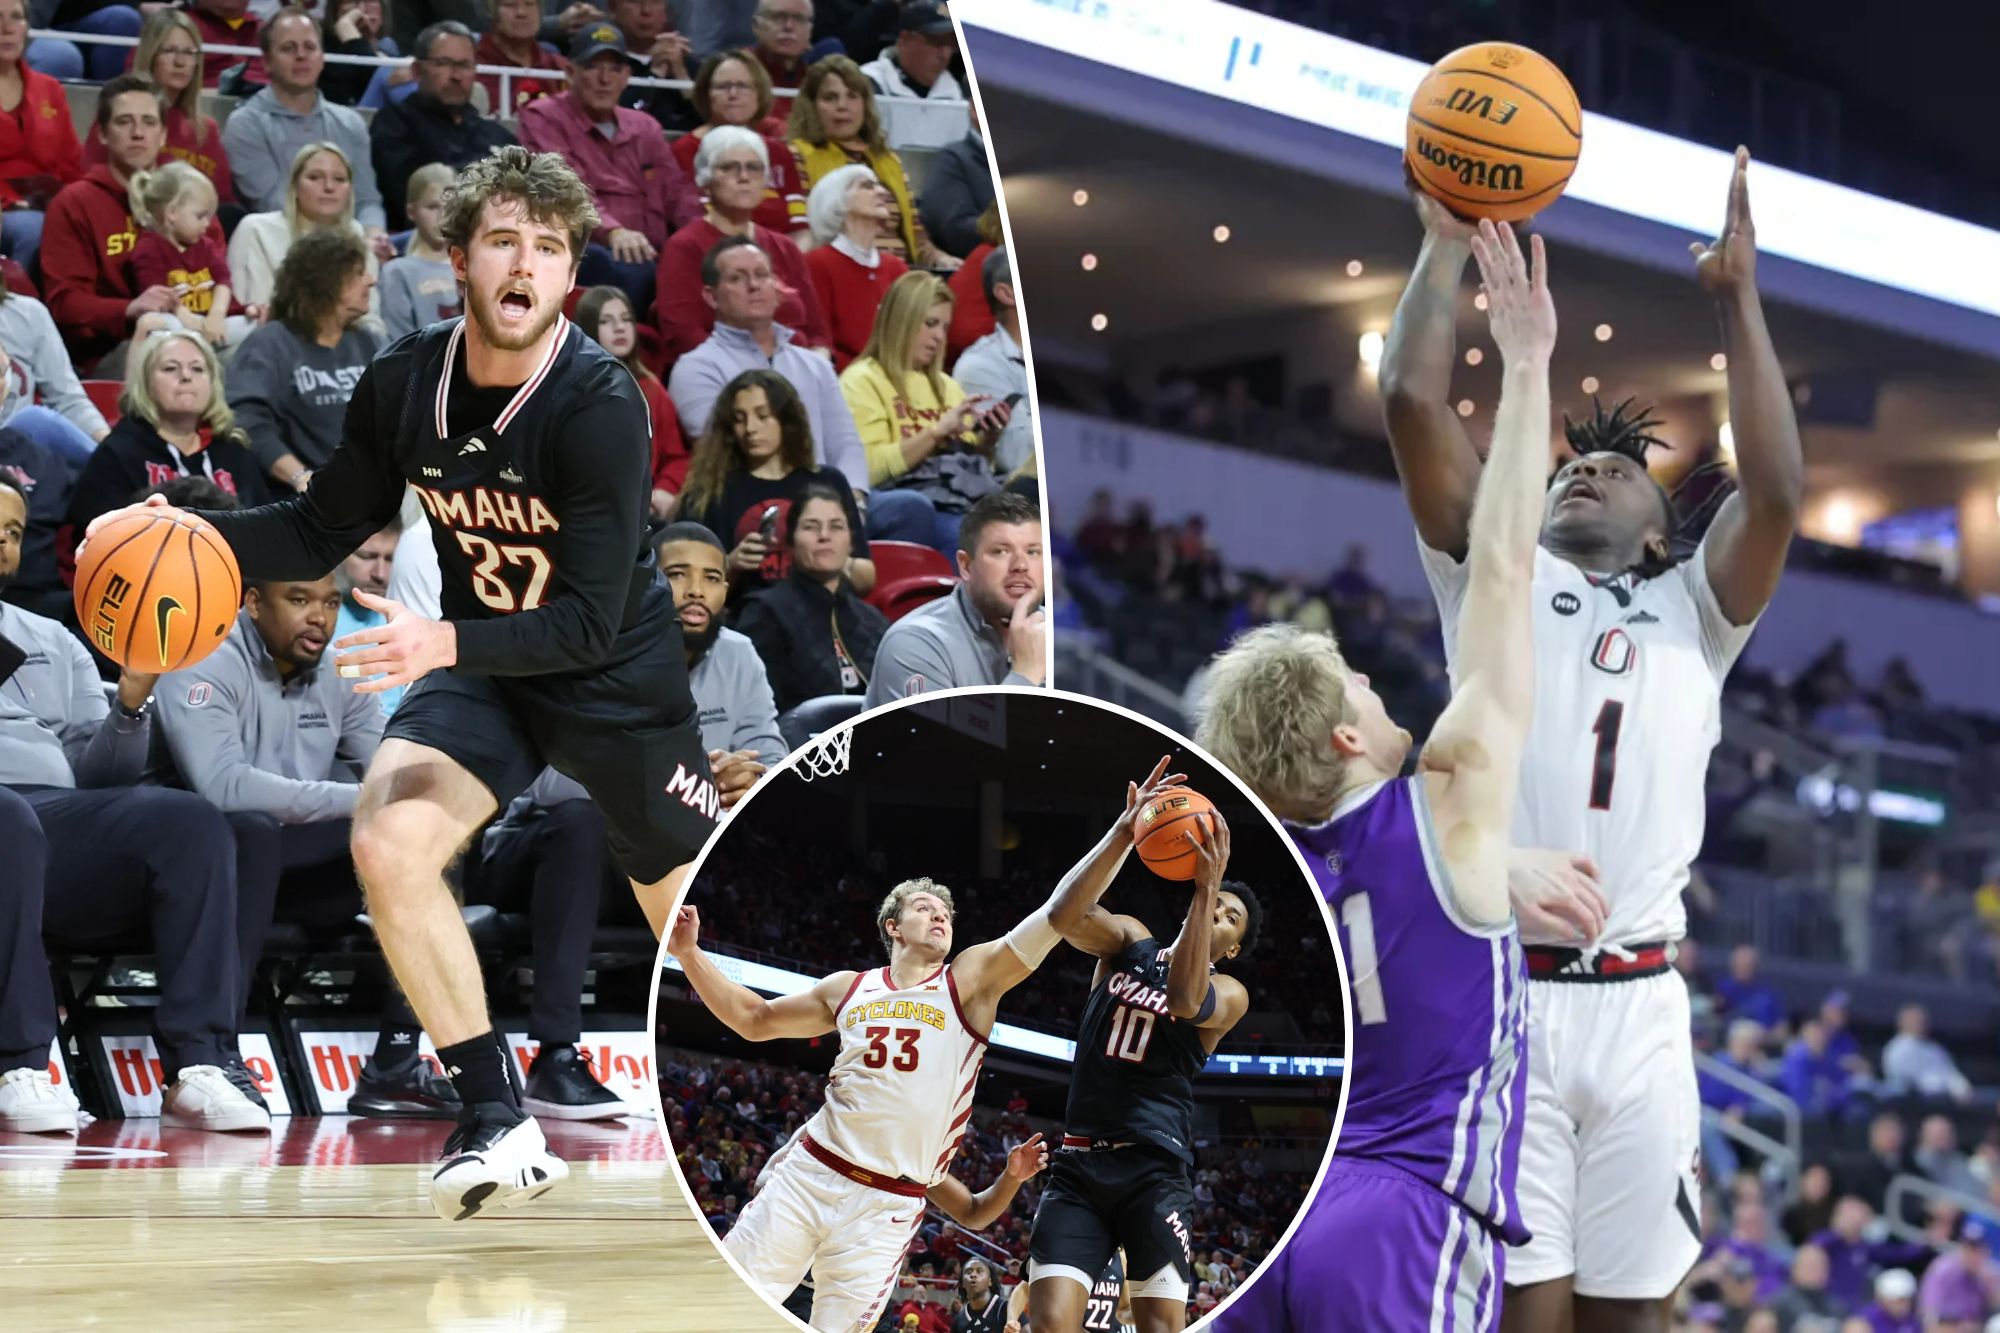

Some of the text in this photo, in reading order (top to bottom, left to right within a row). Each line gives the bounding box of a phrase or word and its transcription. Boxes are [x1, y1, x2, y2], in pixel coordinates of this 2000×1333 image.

[1445, 87, 1518, 125] EVO
[1417, 135, 1524, 190] Wilson
[422, 466, 443, 478] HH
[95, 572, 132, 653] ELITE
[1588, 699, 1625, 812] 1
[665, 763, 720, 822] MAV
[1142, 796, 1189, 824] ELITE
[1328, 890, 1388, 1025] 1
[847, 1001, 945, 1031] CYCLONES
[1106, 1005, 1156, 1062] 10
[863, 1026, 921, 1072] 33
[1094, 1281, 1120, 1297] AHA
[1085, 1299, 1114, 1330] 22
